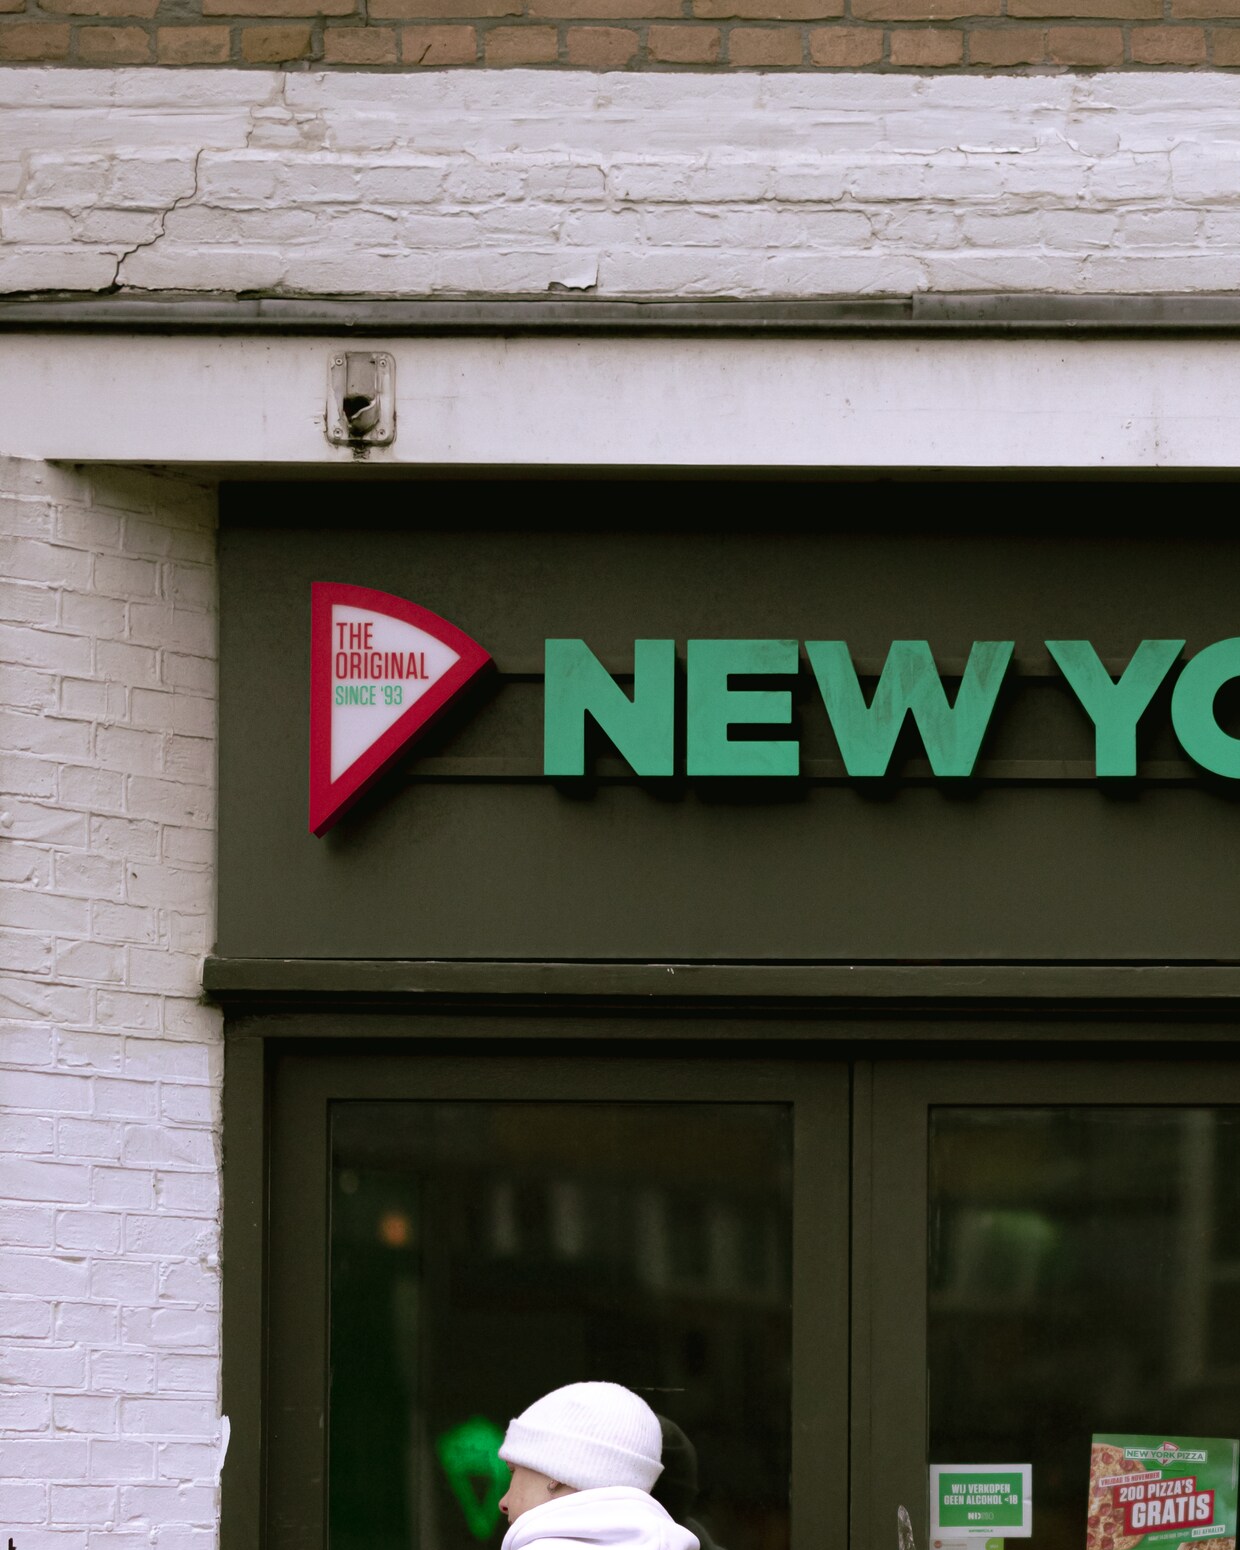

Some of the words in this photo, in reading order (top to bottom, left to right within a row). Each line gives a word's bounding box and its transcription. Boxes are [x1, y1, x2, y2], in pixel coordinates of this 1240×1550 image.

[336, 623, 373, 650] THE
[335, 652, 429, 679] ORIGINAL
[335, 685, 376, 705] SINCE
[380, 685, 403, 705] '93
[544, 638, 1015, 776] NEW
[1127, 1450, 1149, 1458] NEW
[1151, 1450, 1176, 1459] YORK
[1177, 1452, 1204, 1460] PIZZA
[1131, 1472, 1160, 1482] NOVEMBER
[951, 1484, 966, 1494] WIJ
[968, 1484, 1010, 1494] VERKOPEN
[1119, 1485, 1144, 1502] 200
[1148, 1479, 1193, 1498] PIZZA'S
[944, 1495, 964, 1505] GEEN
[966, 1495, 1002, 1505] ALCOHOL
[1004, 1495, 1018, 1505] <18
[1132, 1494, 1210, 1528] GRATIS
